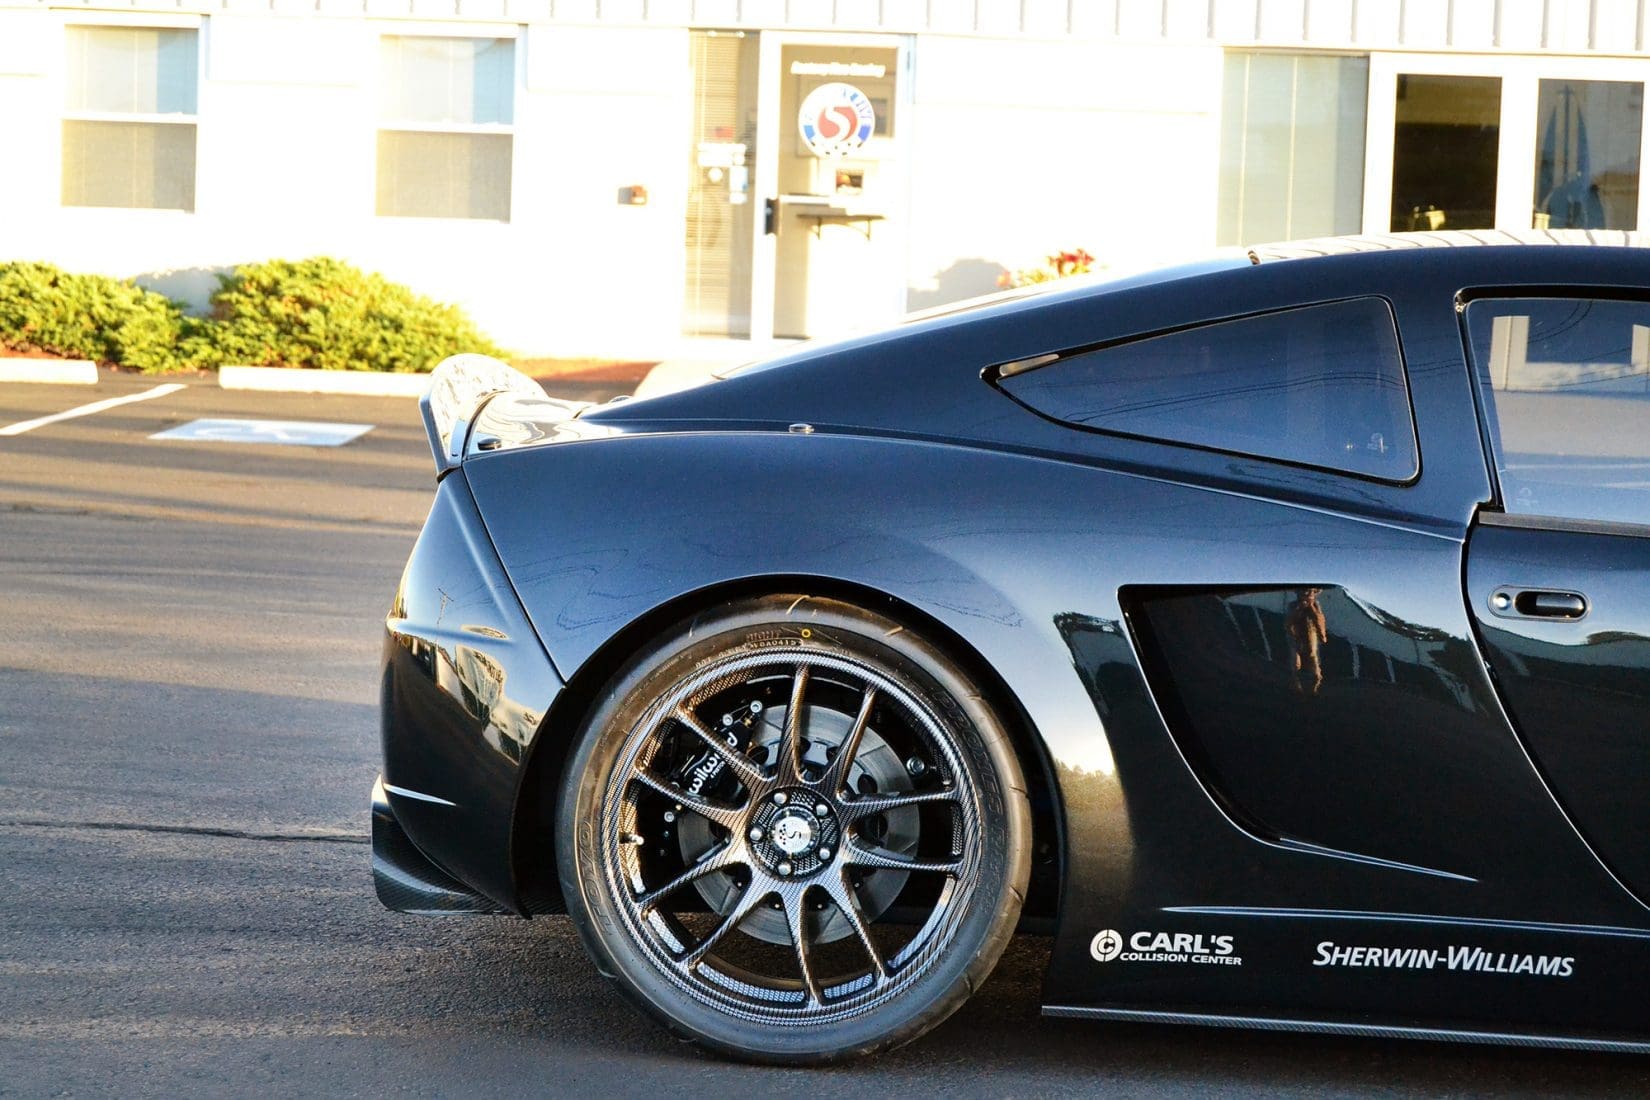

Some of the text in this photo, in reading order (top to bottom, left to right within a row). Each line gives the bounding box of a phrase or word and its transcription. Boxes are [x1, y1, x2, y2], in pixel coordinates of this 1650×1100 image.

[688, 731, 738, 794] wilwd
[579, 820, 613, 935] TOYO
[1119, 952, 1243, 966] COLLISION CENTER
[1129, 931, 1234, 955] CARL'S
[1312, 941, 1575, 977] SHERWIN-WILLIAMS
